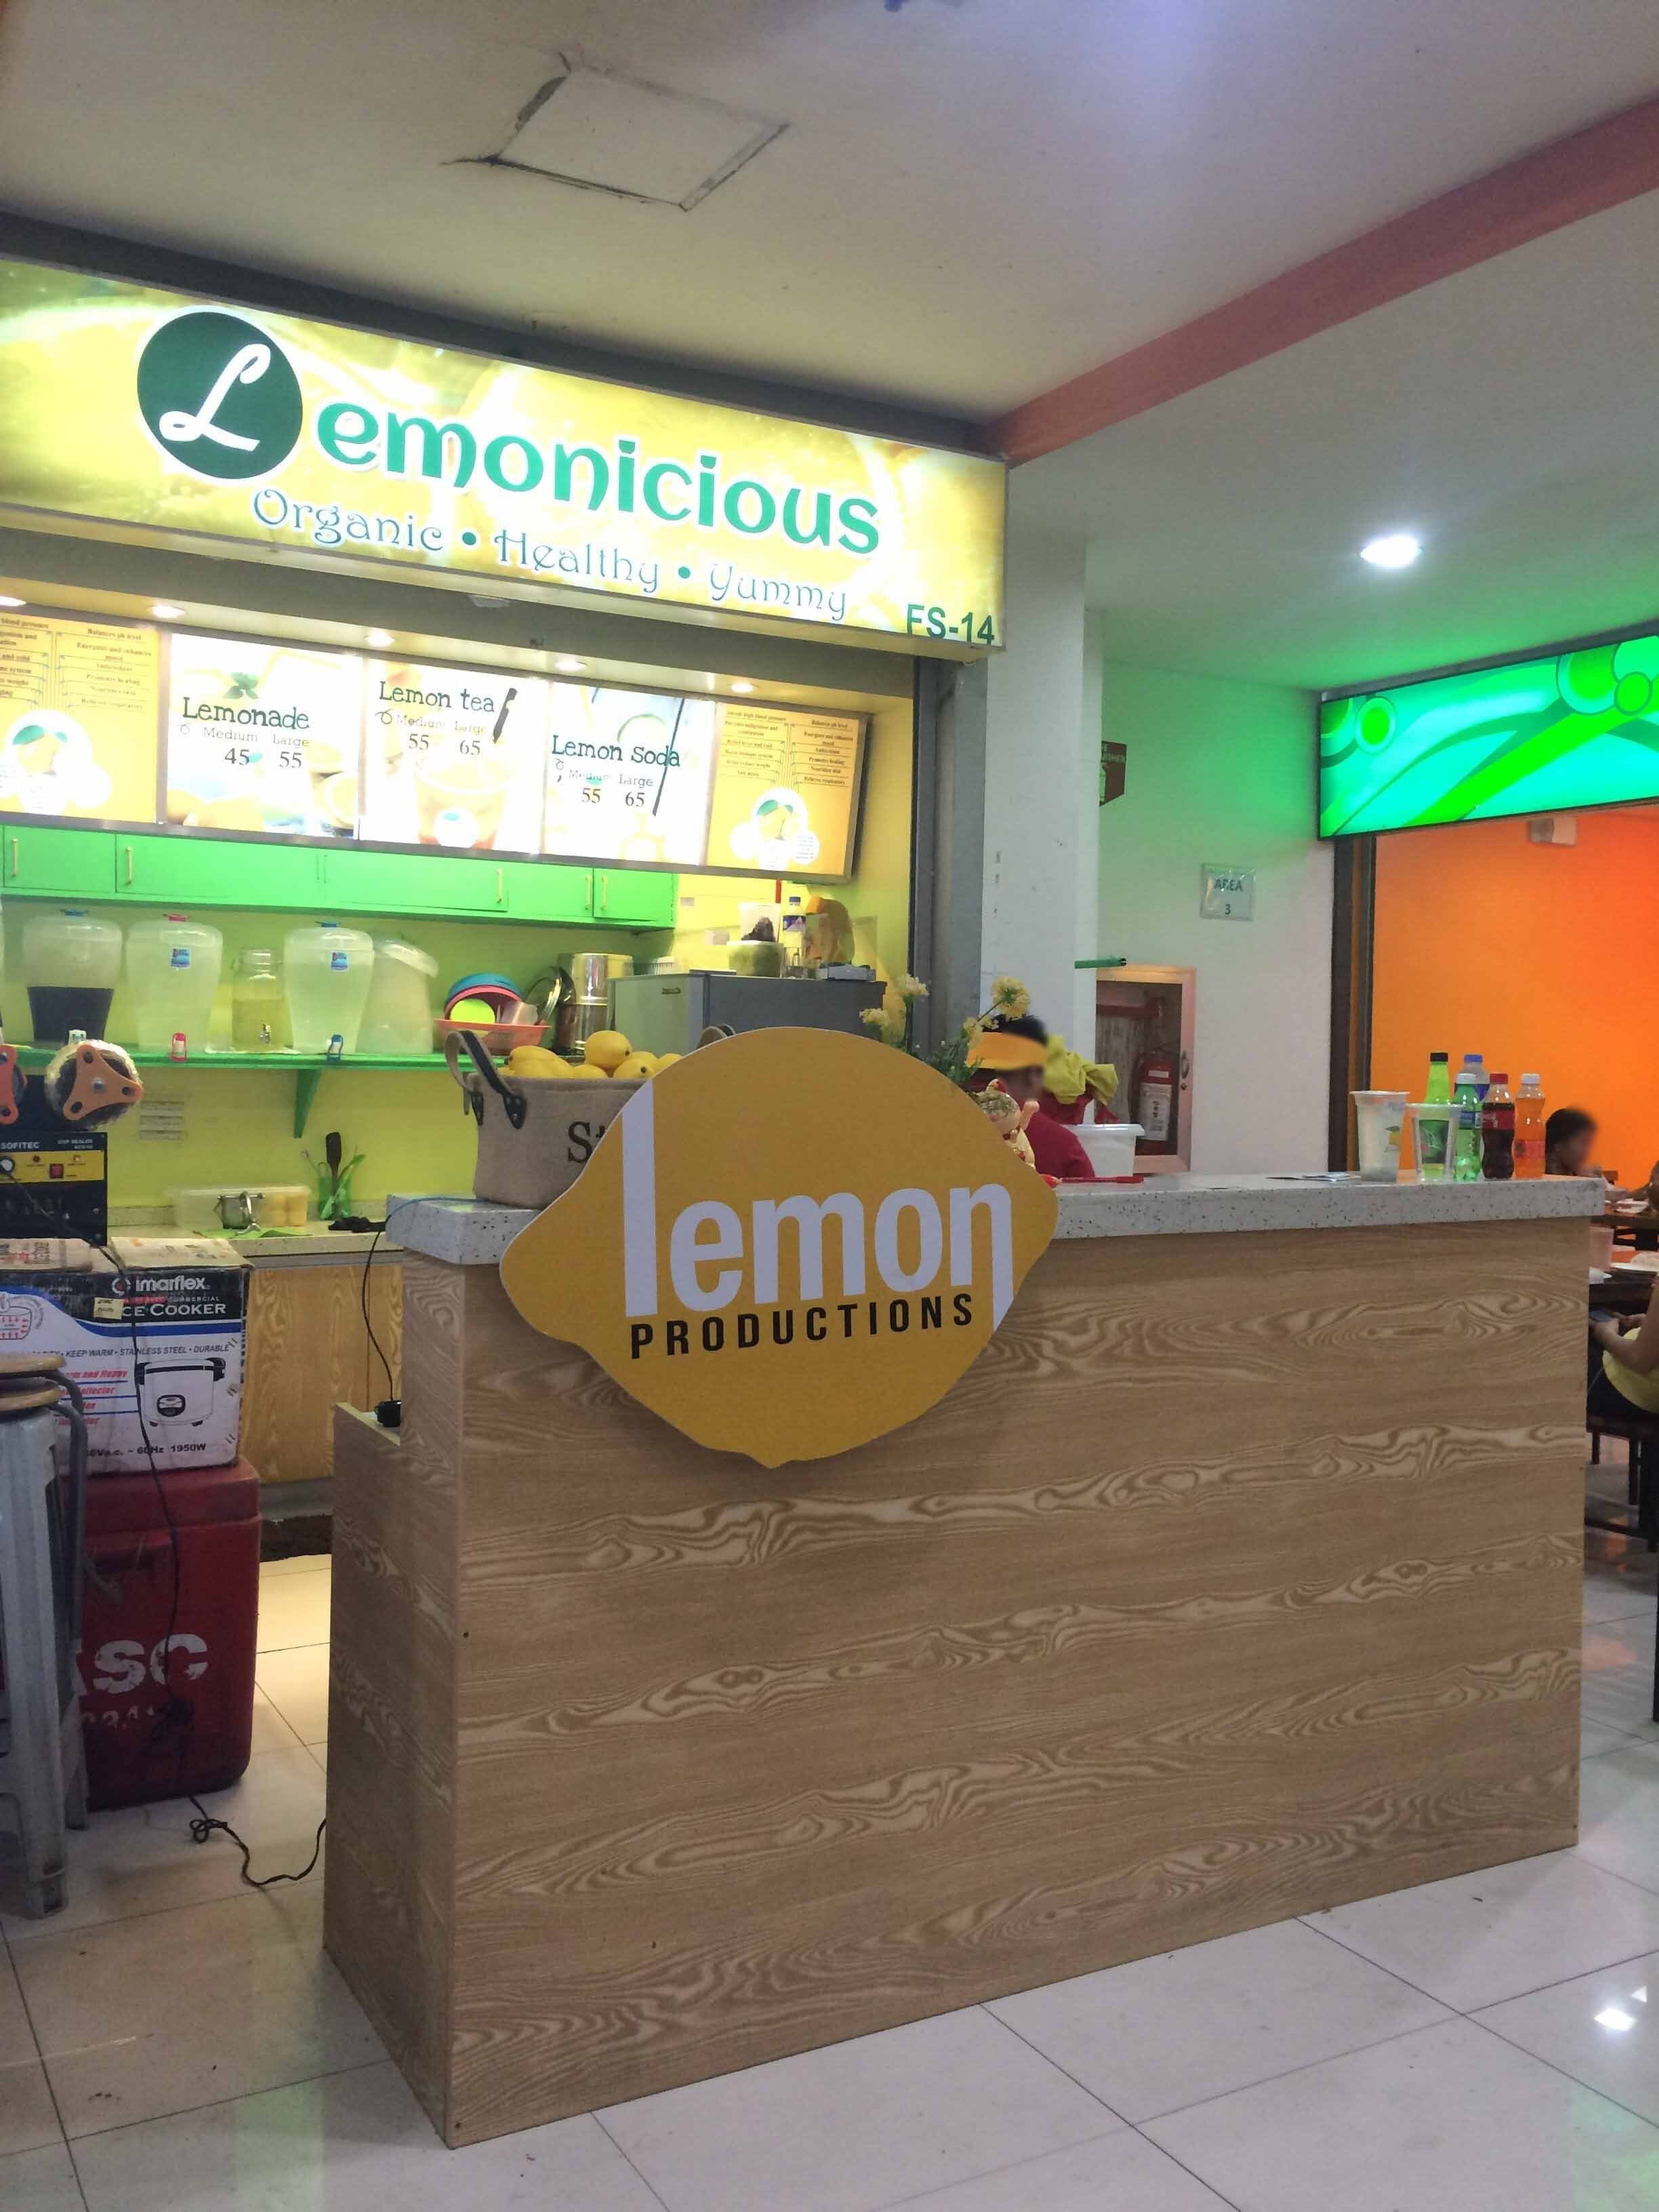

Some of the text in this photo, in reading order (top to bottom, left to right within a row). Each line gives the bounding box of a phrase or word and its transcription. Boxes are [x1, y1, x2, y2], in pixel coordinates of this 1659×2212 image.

[159, 343, 880, 554] Lemonicious
[253, 489, 847, 621] Organic Healthy Yummy
[906, 604, 995, 645] FS-14
[379, 680, 495, 712] Lemon tea
[182, 696, 310, 730] Lemonade
[203, 726, 310, 749] Medium Large
[408, 733, 481, 756] 55 65
[552, 735, 623, 761] Lemon
[224, 747, 302, 769] 45 55
[618, 773, 654, 789] Large
[581, 787, 645, 808] 55 65
[1214, 878, 1243, 892] AREA
[1225, 903, 1231, 916] 3
[622, 1080, 1013, 1332] lemon
[136, 1275, 207, 1292] imarflex
[631, 1293, 974, 1359] PRODUCTIONS
[119, 1347, 162, 1355] STANLESS
[163, 1346, 187, 1354] STEEL
[194, 1344, 230, 1353] DURABLE
[170, 1443, 207, 1453] 1950W
